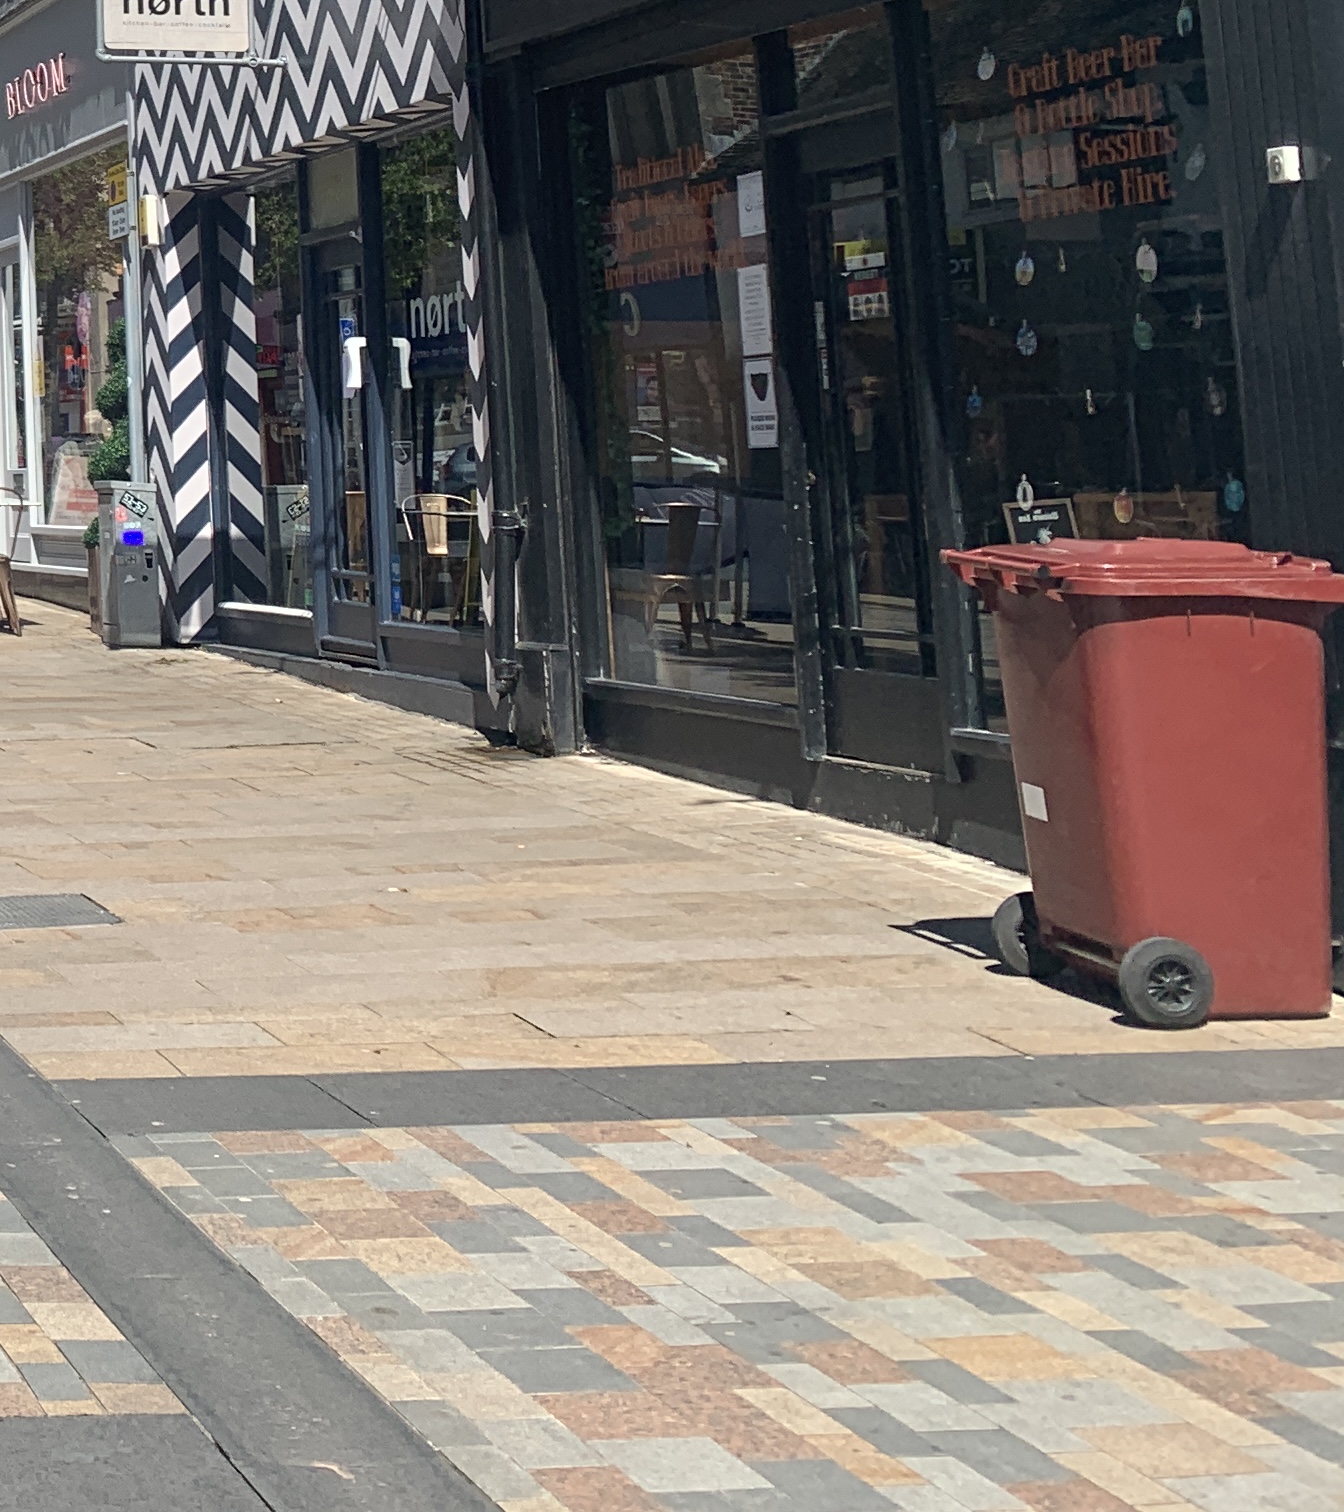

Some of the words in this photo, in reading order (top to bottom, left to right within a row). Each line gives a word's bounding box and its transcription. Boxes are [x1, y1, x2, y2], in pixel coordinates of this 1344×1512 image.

[1120, 34, 1162, 72] Bar
[5, 52, 69, 120] BLOOM
[410, 280, 467, 339] nørt
